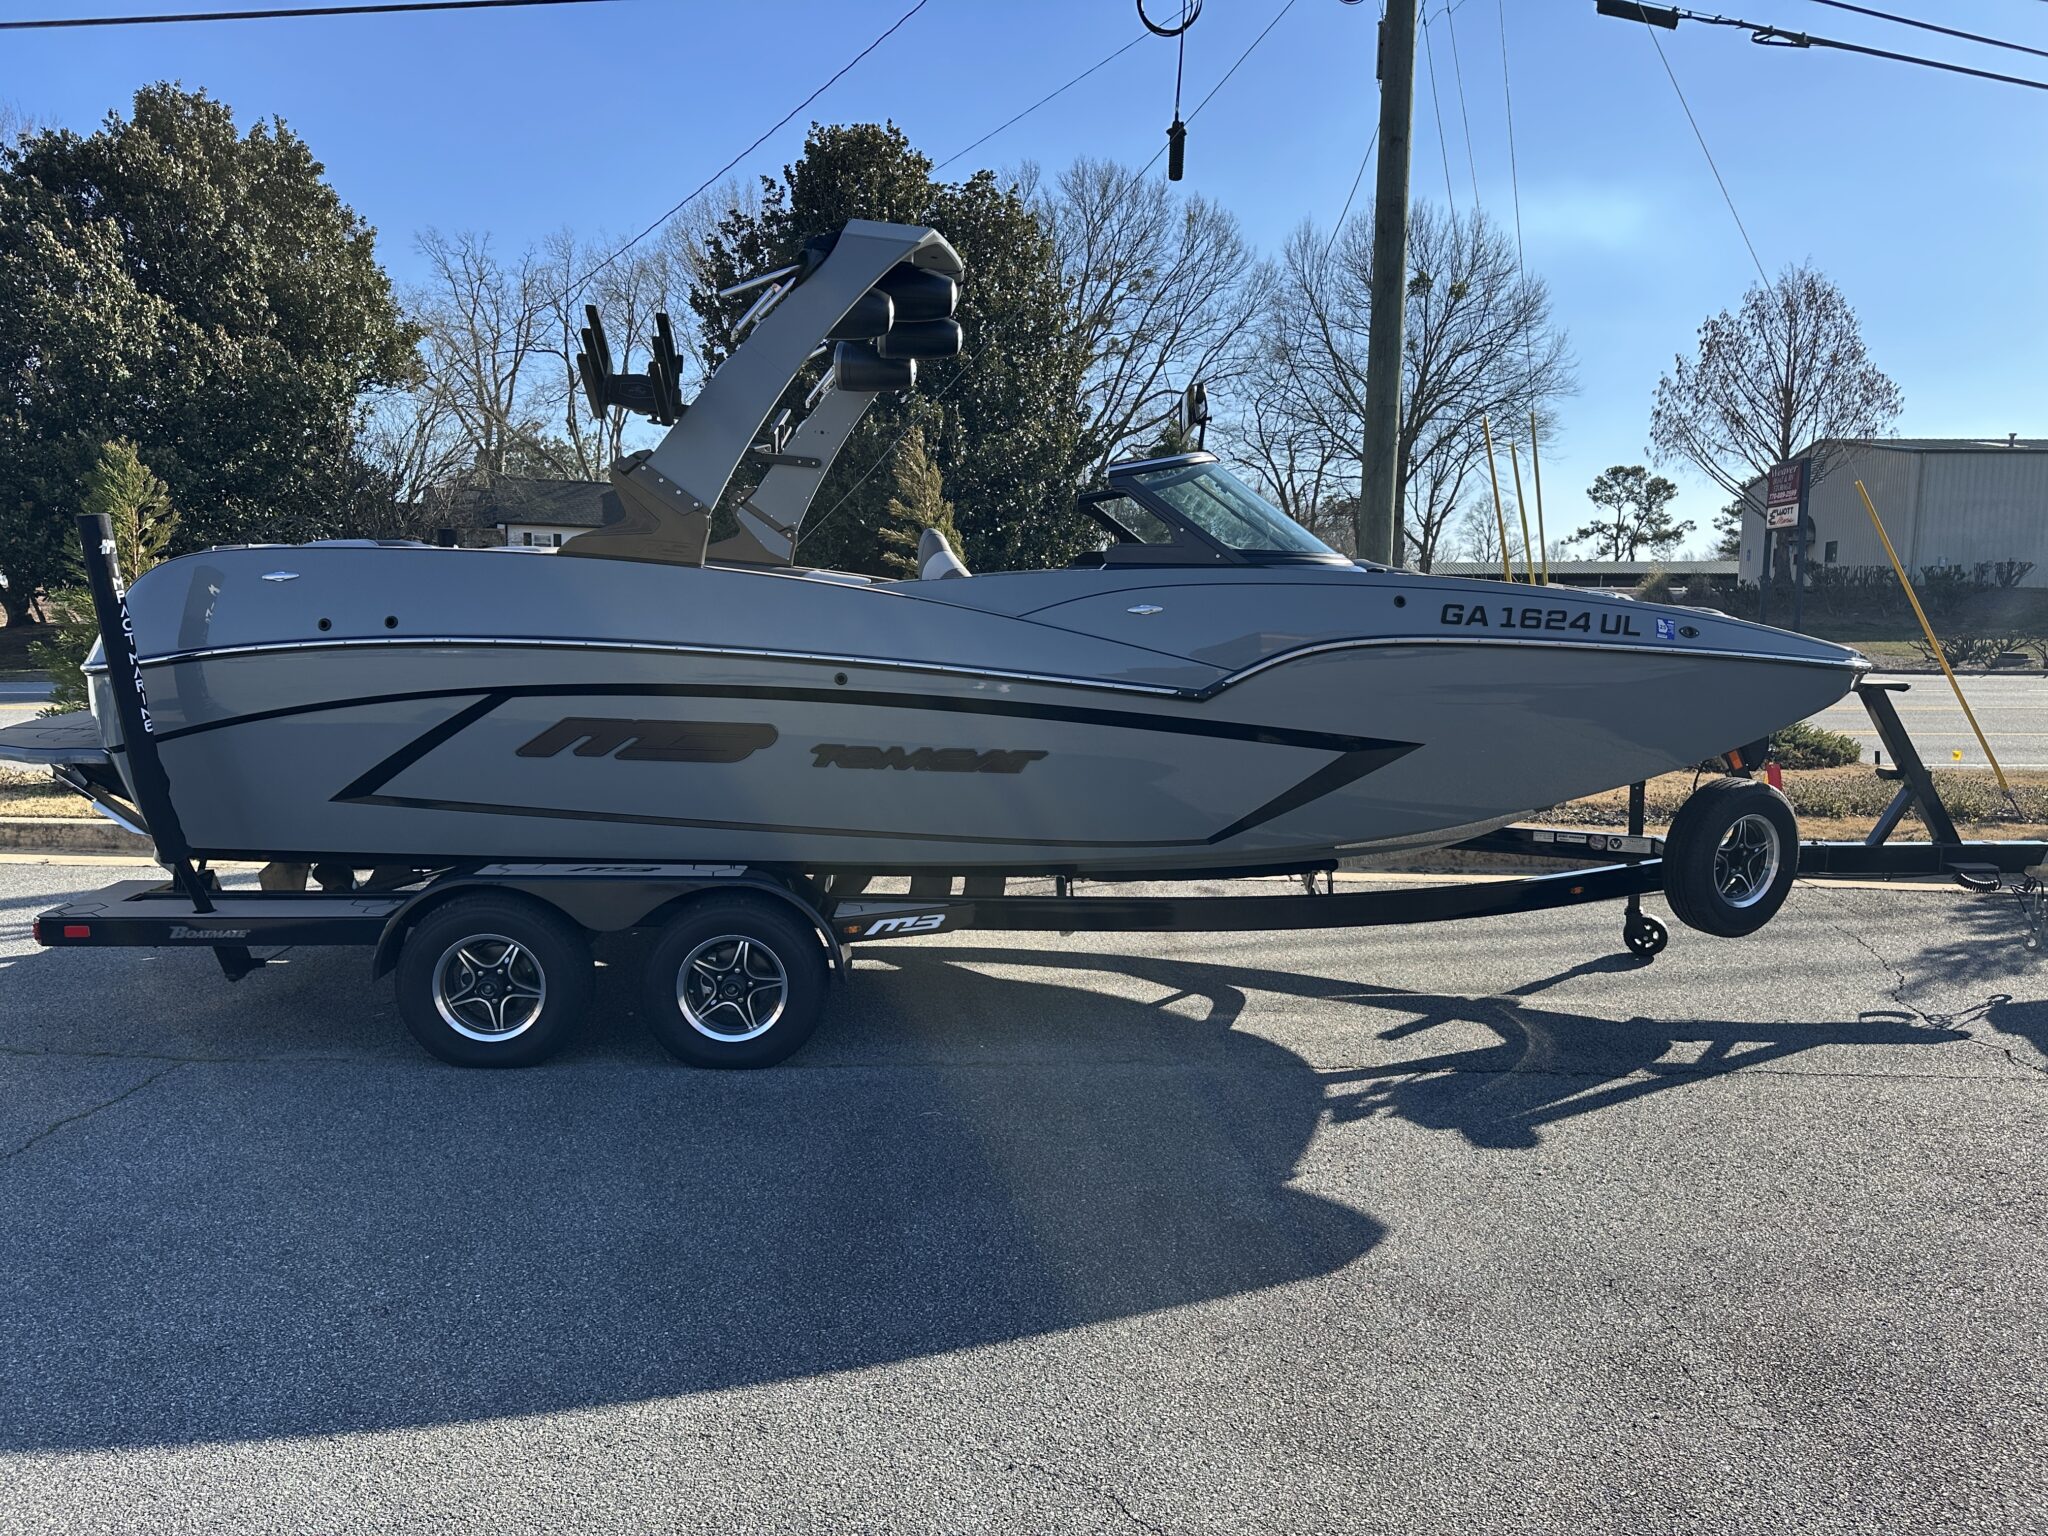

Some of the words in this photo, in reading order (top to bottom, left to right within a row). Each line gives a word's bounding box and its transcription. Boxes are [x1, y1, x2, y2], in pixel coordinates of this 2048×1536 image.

[112, 562, 136, 646] IMPACT
[128, 652, 154, 733] MARINE
[1440, 604, 1489, 627] GA
[1500, 606, 1591, 633] 1624
[1600, 613, 1641, 637] UL
